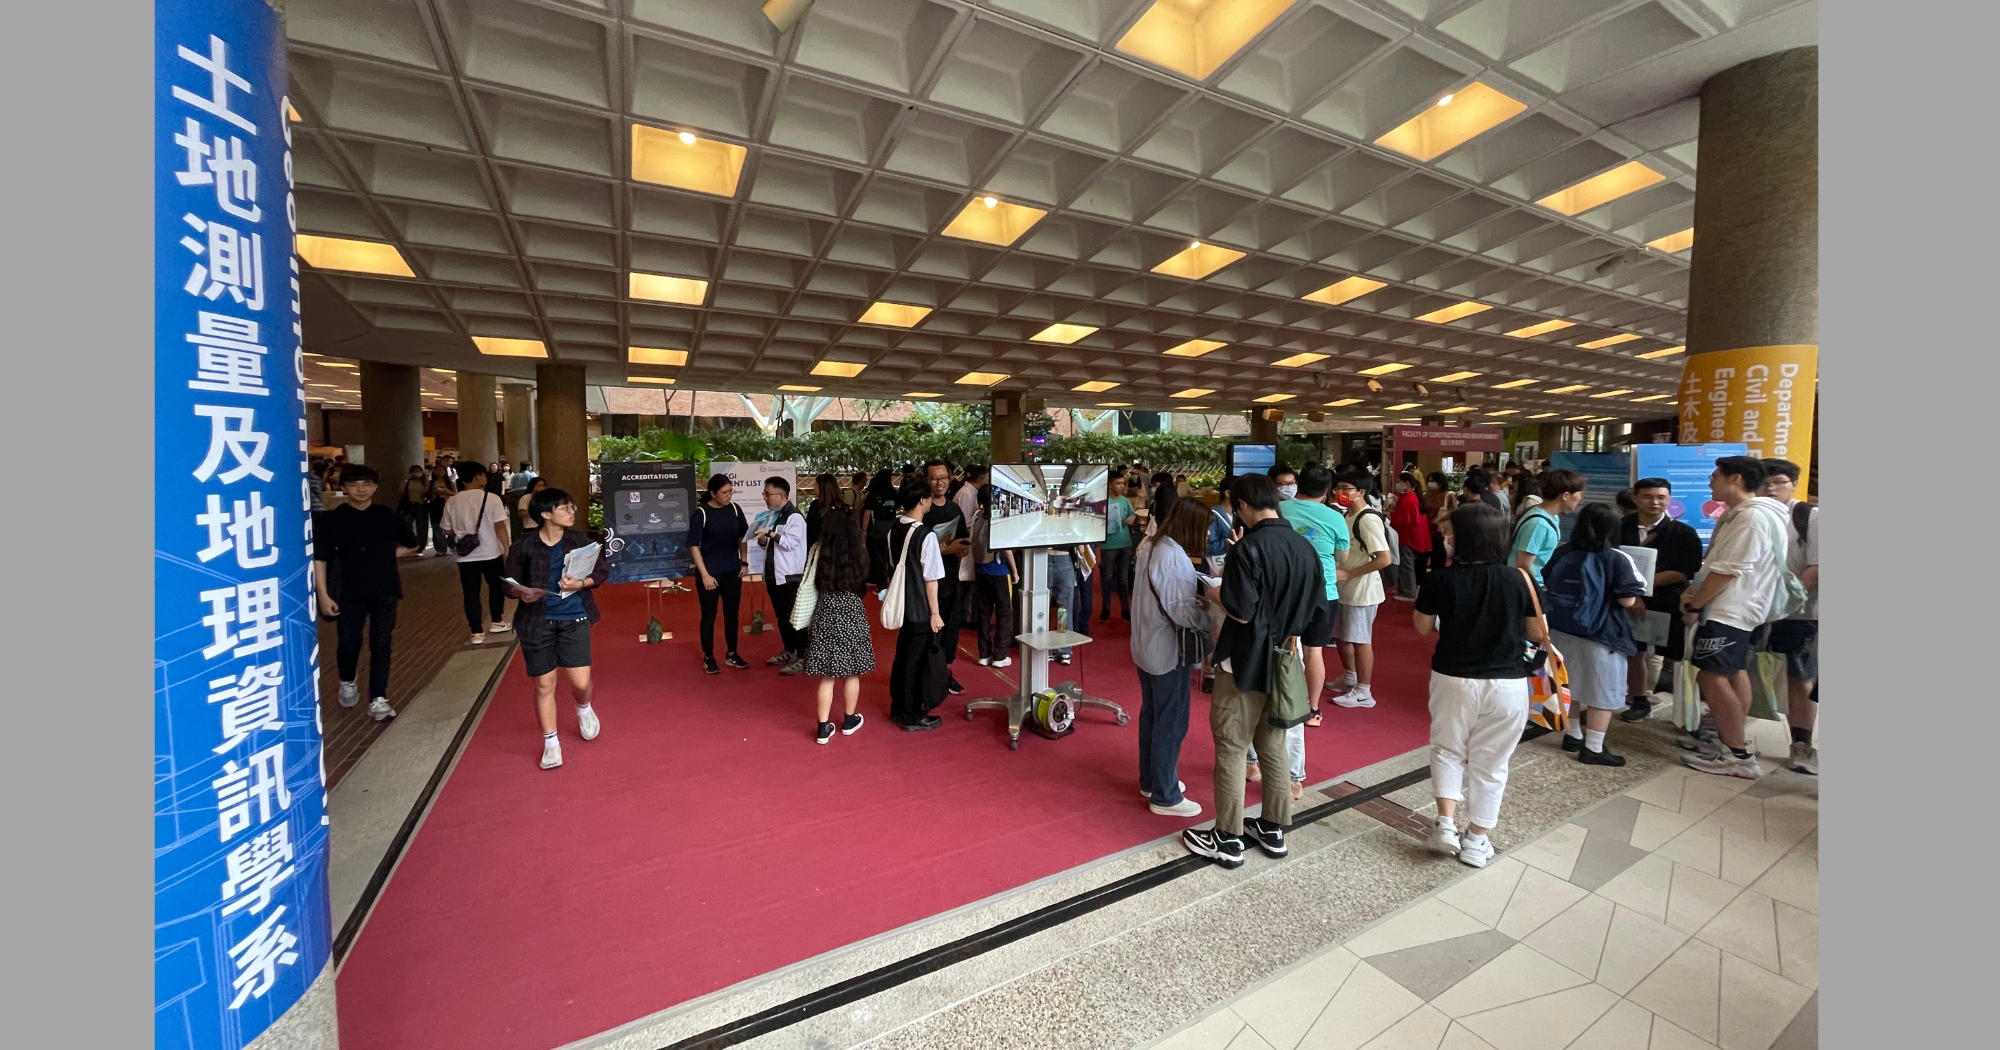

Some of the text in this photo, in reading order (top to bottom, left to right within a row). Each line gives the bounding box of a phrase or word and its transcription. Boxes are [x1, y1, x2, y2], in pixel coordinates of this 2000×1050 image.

[1708, 367, 1735, 442] Enginee
[1744, 364, 1770, 404] Civil
[1772, 363, 1800, 459] Departme
[1401, 430, 1421, 438] FACULTY
[1741, 409, 1765, 442] and
[171, 34, 300, 1011] 土地測量及地理資訊學系
